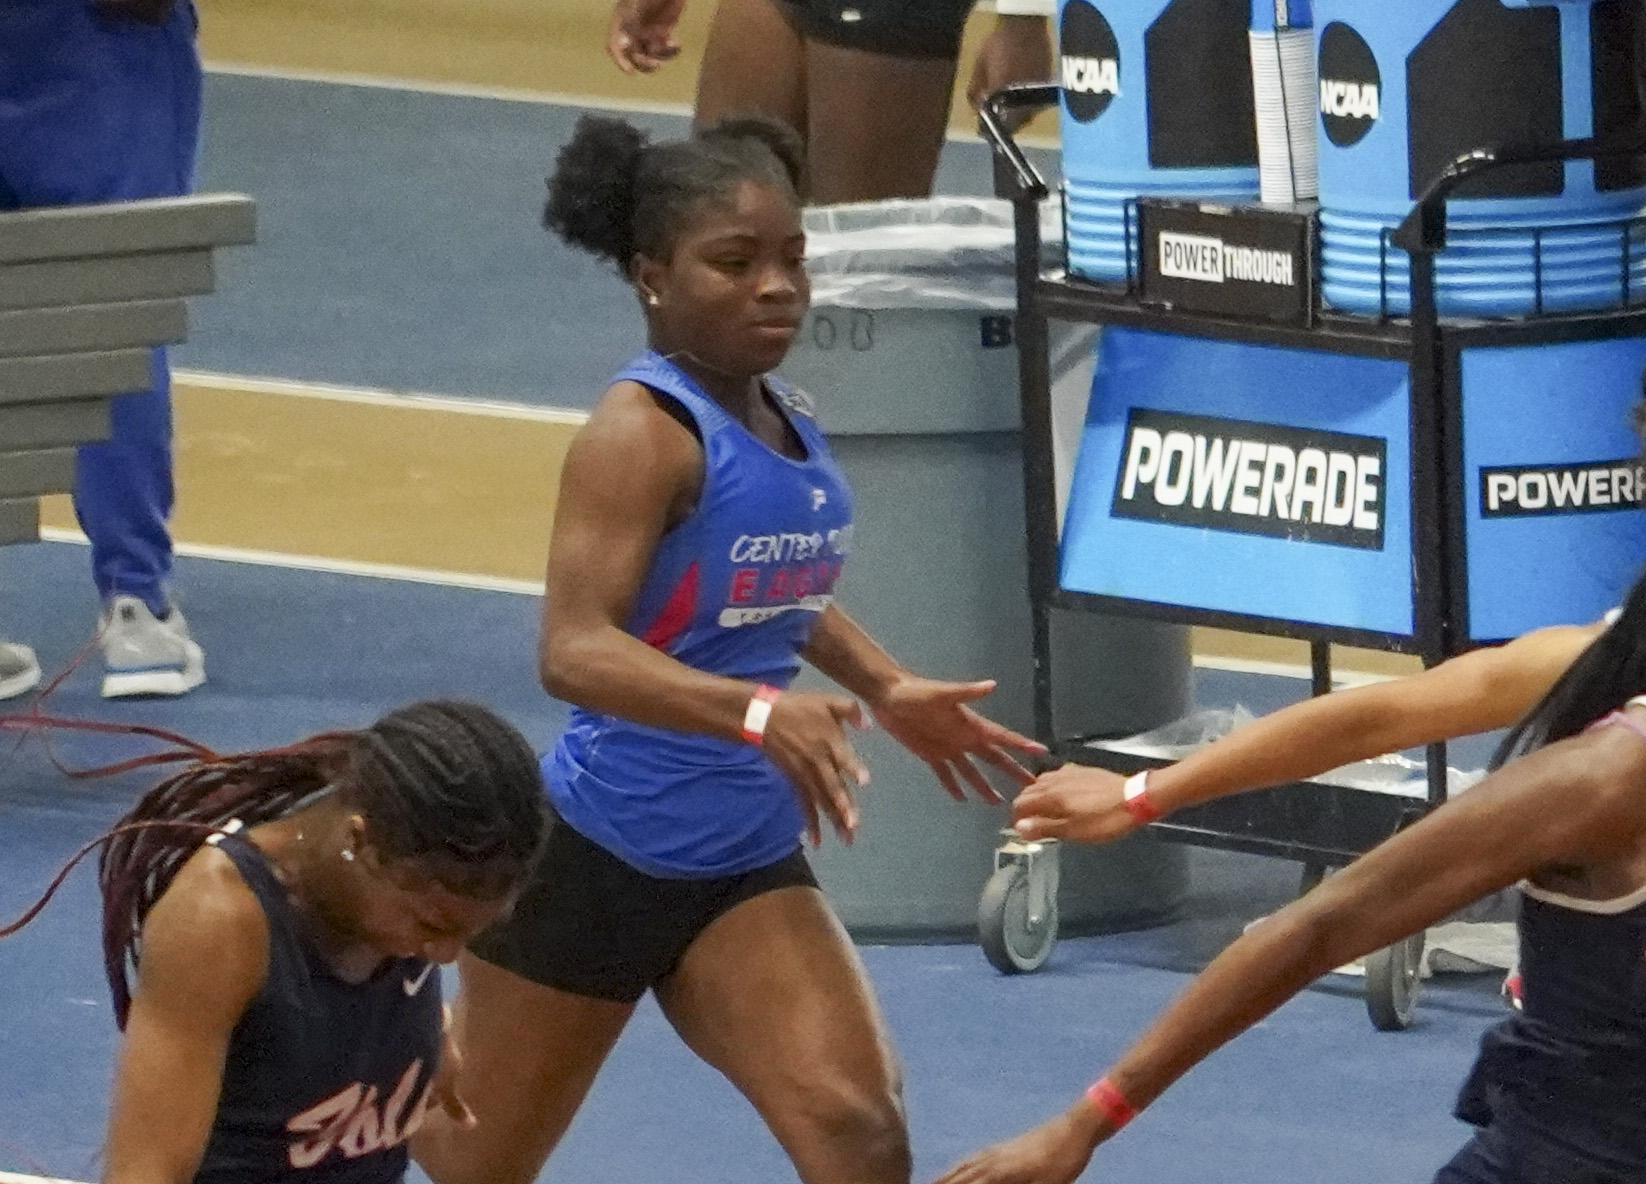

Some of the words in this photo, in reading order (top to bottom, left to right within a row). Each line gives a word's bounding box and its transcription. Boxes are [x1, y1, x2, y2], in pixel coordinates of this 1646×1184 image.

[1061, 55, 1120, 96] NCAA
[1319, 79, 1380, 120] NCAA
[1163, 240, 1221, 276] POWER
[1223, 245, 1295, 286] THROUGH
[1121, 426, 1381, 531] POWERADE
